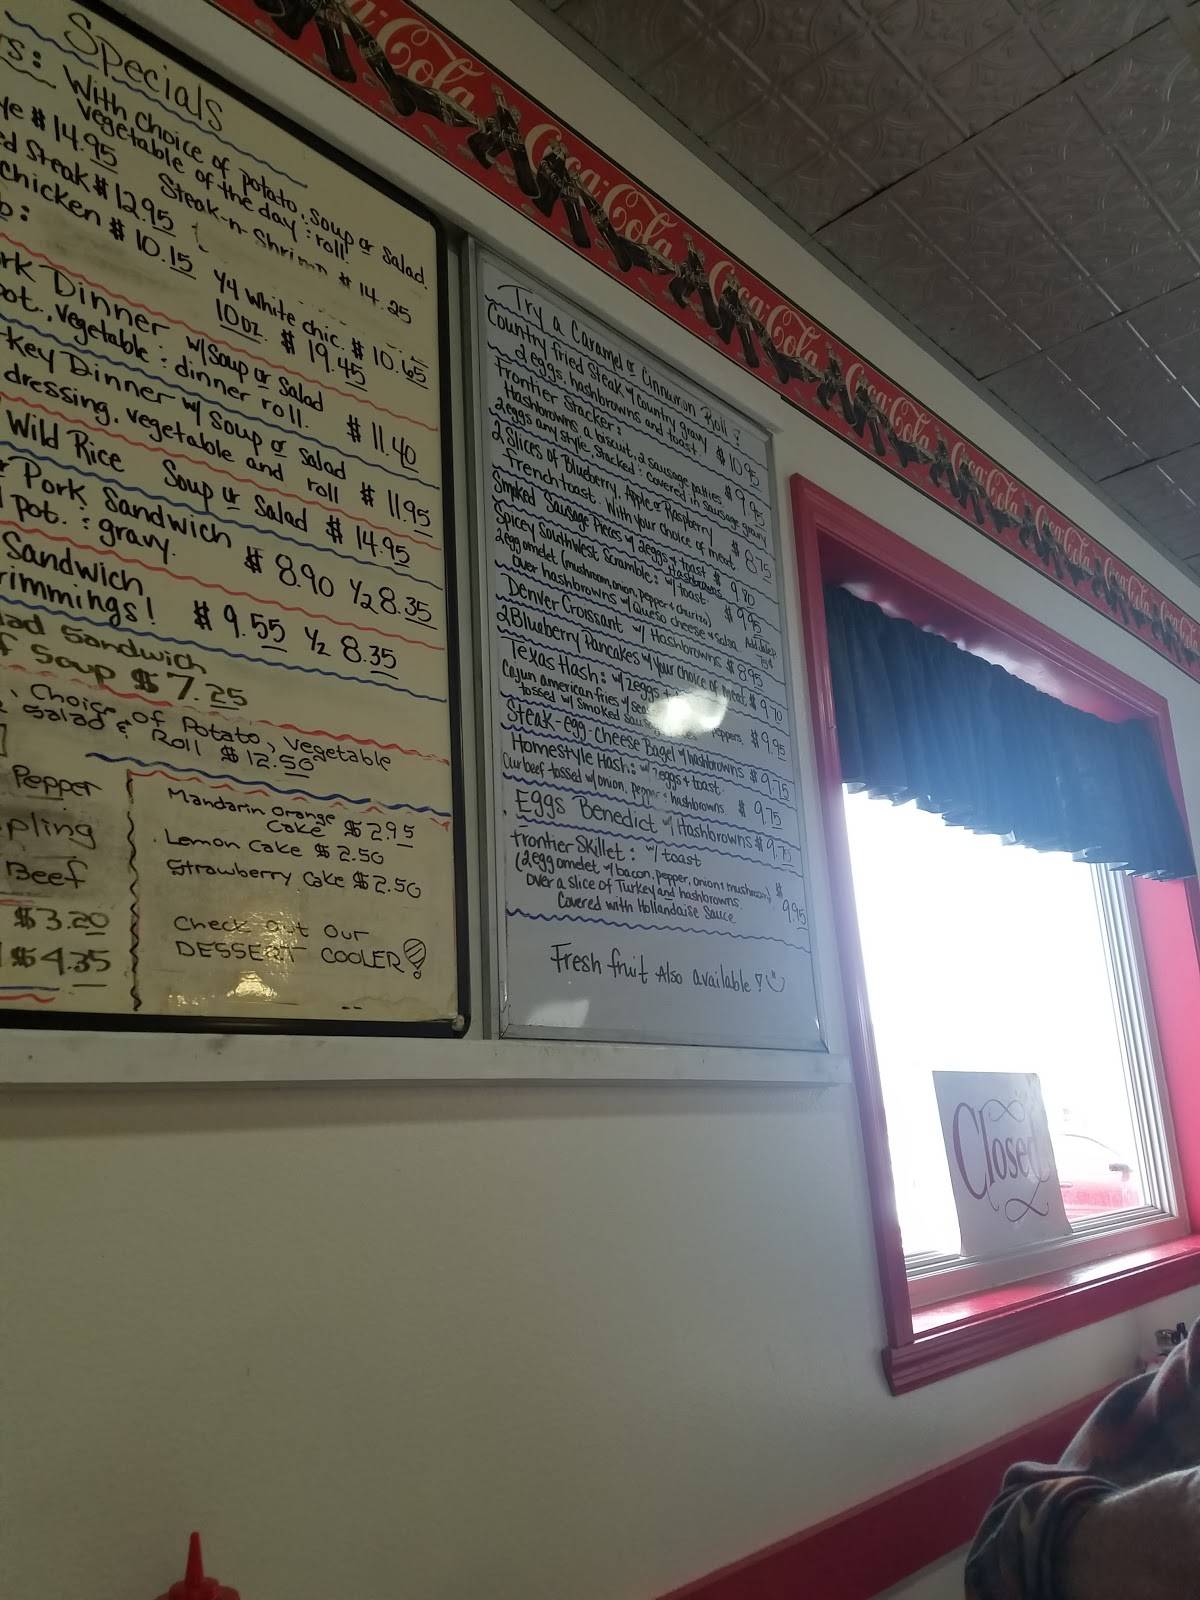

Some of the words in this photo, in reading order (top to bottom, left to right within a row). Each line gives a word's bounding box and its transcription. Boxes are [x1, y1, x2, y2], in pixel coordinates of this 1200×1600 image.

[64, 13, 223, 131] Specials
[63, 64, 127, 120] With
[211, 155, 231, 181] of
[26, 138, 92, 193] Steak
[195, 168, 215, 191] of
[217, 181, 255, 213] the
[258, 202, 298, 243] day
[39, 264, 171, 336] Dinner
[280, 376, 324, 412] Salad
[498, 284, 545, 333] Try
[553, 316, 566, 336] a
[572, 320, 624, 371] Caramel
[175, 354, 251, 402] dinner
[488, 302, 549, 361] Country
[587, 362, 625, 398] Steak
[636, 394, 683, 433] Country
[60, 350, 176, 404] Dinner
[209, 410, 263, 458] Soup
[299, 447, 346, 480] Salad
[535, 418, 558, 443] any
[126, 407, 235, 462] vegetable
[246, 457, 285, 483] and
[307, 478, 339, 504] roll
[644, 418, 668, 438] and
[672, 429, 697, 455] toast
[6, 410, 59, 450] Wild
[67, 429, 125, 473] Rice
[162, 459, 214, 513] Soup
[254, 494, 308, 533] Salad
[546, 448, 559, 470] of
[8, 457, 88, 506] Pork
[102, 486, 232, 549] Sandwich
[2, 531, 144, 596] Sandwich
[500, 574, 560, 612] Denver
[561, 595, 624, 634] Croissant
[500, 636, 556, 671] Texas
[581, 630, 641, 666] Pancakes
[152, 728, 202, 757] Roll
[510, 731, 594, 766] Homestyle
[12, 765, 103, 797] Pepper
[168, 787, 266, 816] Mandarin
[272, 806, 337, 825] Orange
[515, 789, 566, 819] Eggs
[571, 795, 658, 834] Benedict
[164, 828, 241, 850] Lemon
[248, 838, 303, 858] Cake
[267, 820, 322, 838] Cake
[6, 860, 89, 888] Beef
[166, 859, 292, 887] Strawberry
[302, 870, 346, 888] Cake
[661, 848, 702, 868] toast
[556, 877, 567, 890] a
[615, 879, 656, 901] Turkey
[557, 891, 602, 911] Covered
[605, 896, 634, 914] with
[703, 904, 737, 925] Sauce
[551, 942, 603, 975] Fresh
[653, 960, 683, 985] Also
